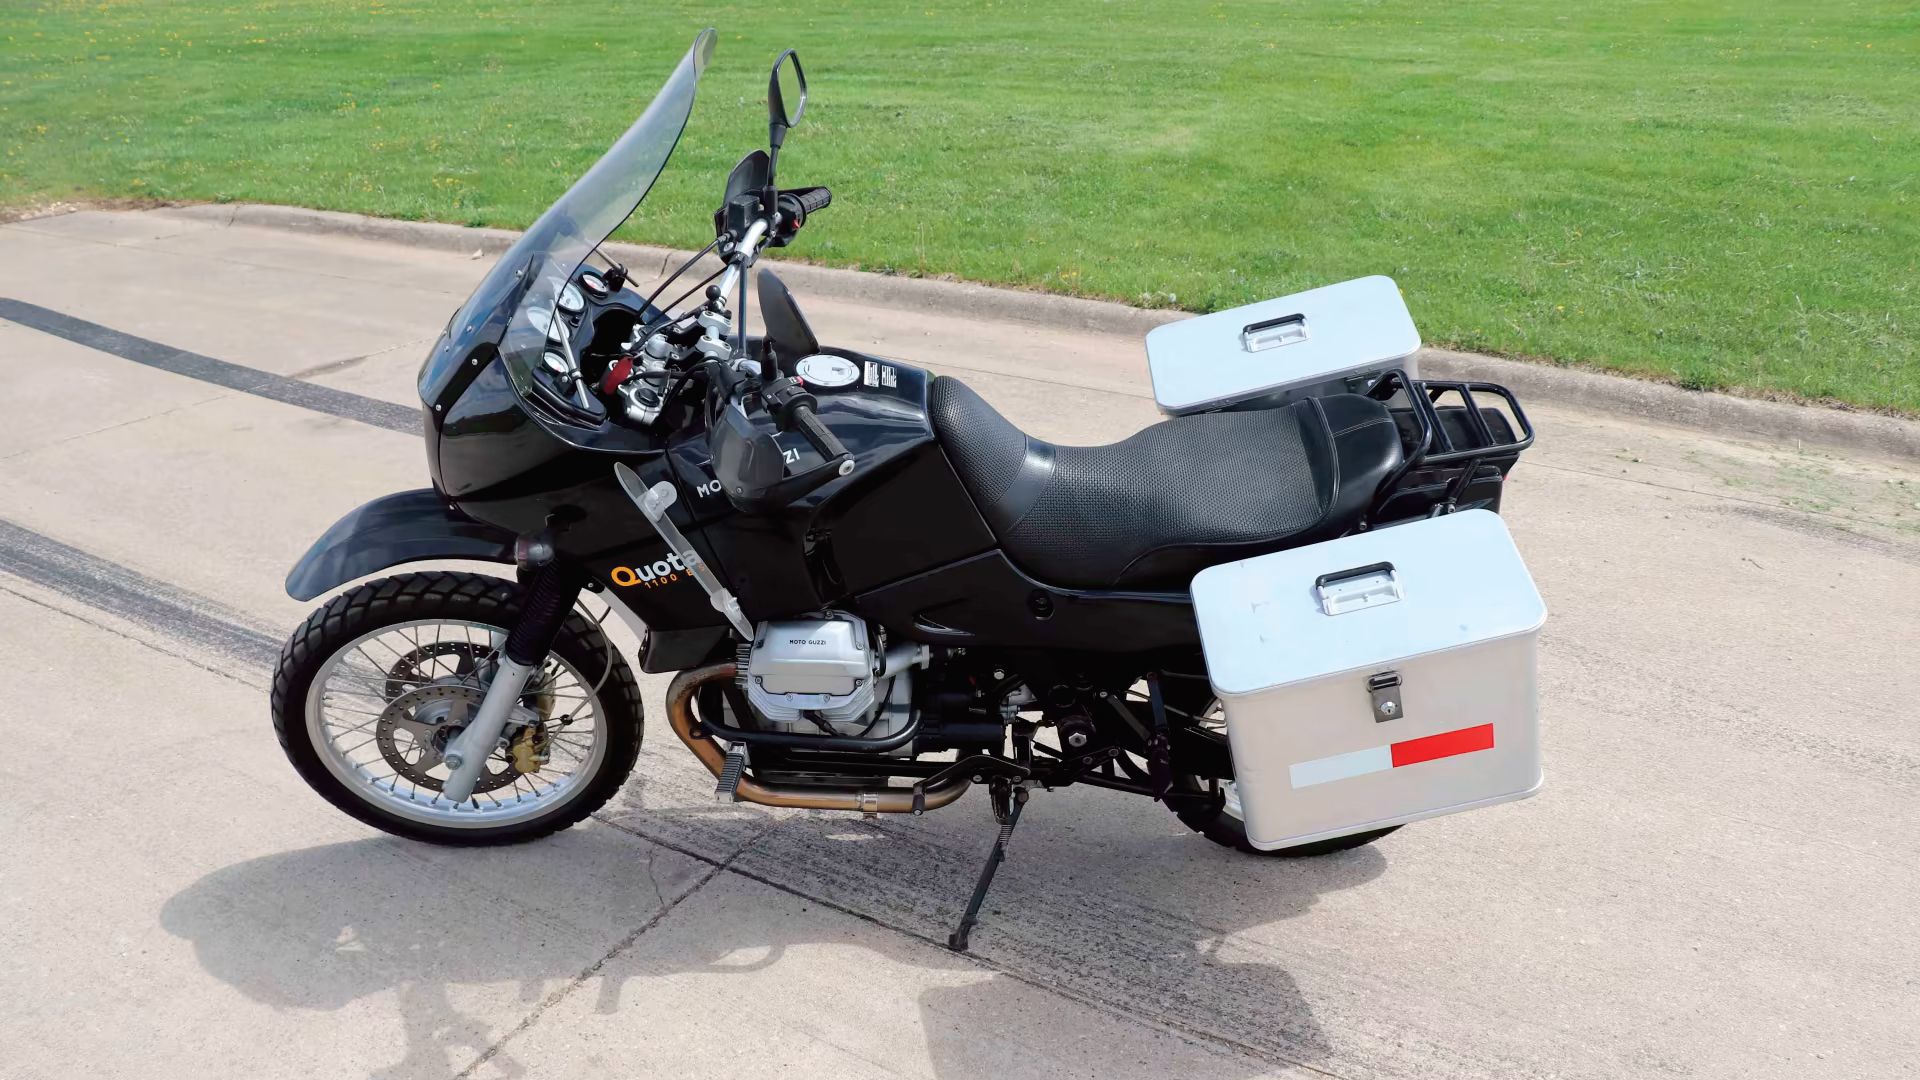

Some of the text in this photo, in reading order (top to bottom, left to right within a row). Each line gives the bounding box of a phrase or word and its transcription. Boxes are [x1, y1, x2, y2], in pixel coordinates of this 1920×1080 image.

[696, 480, 722, 498] MO
[611, 549, 698, 587] Quota
[644, 573, 678, 589] 1100
